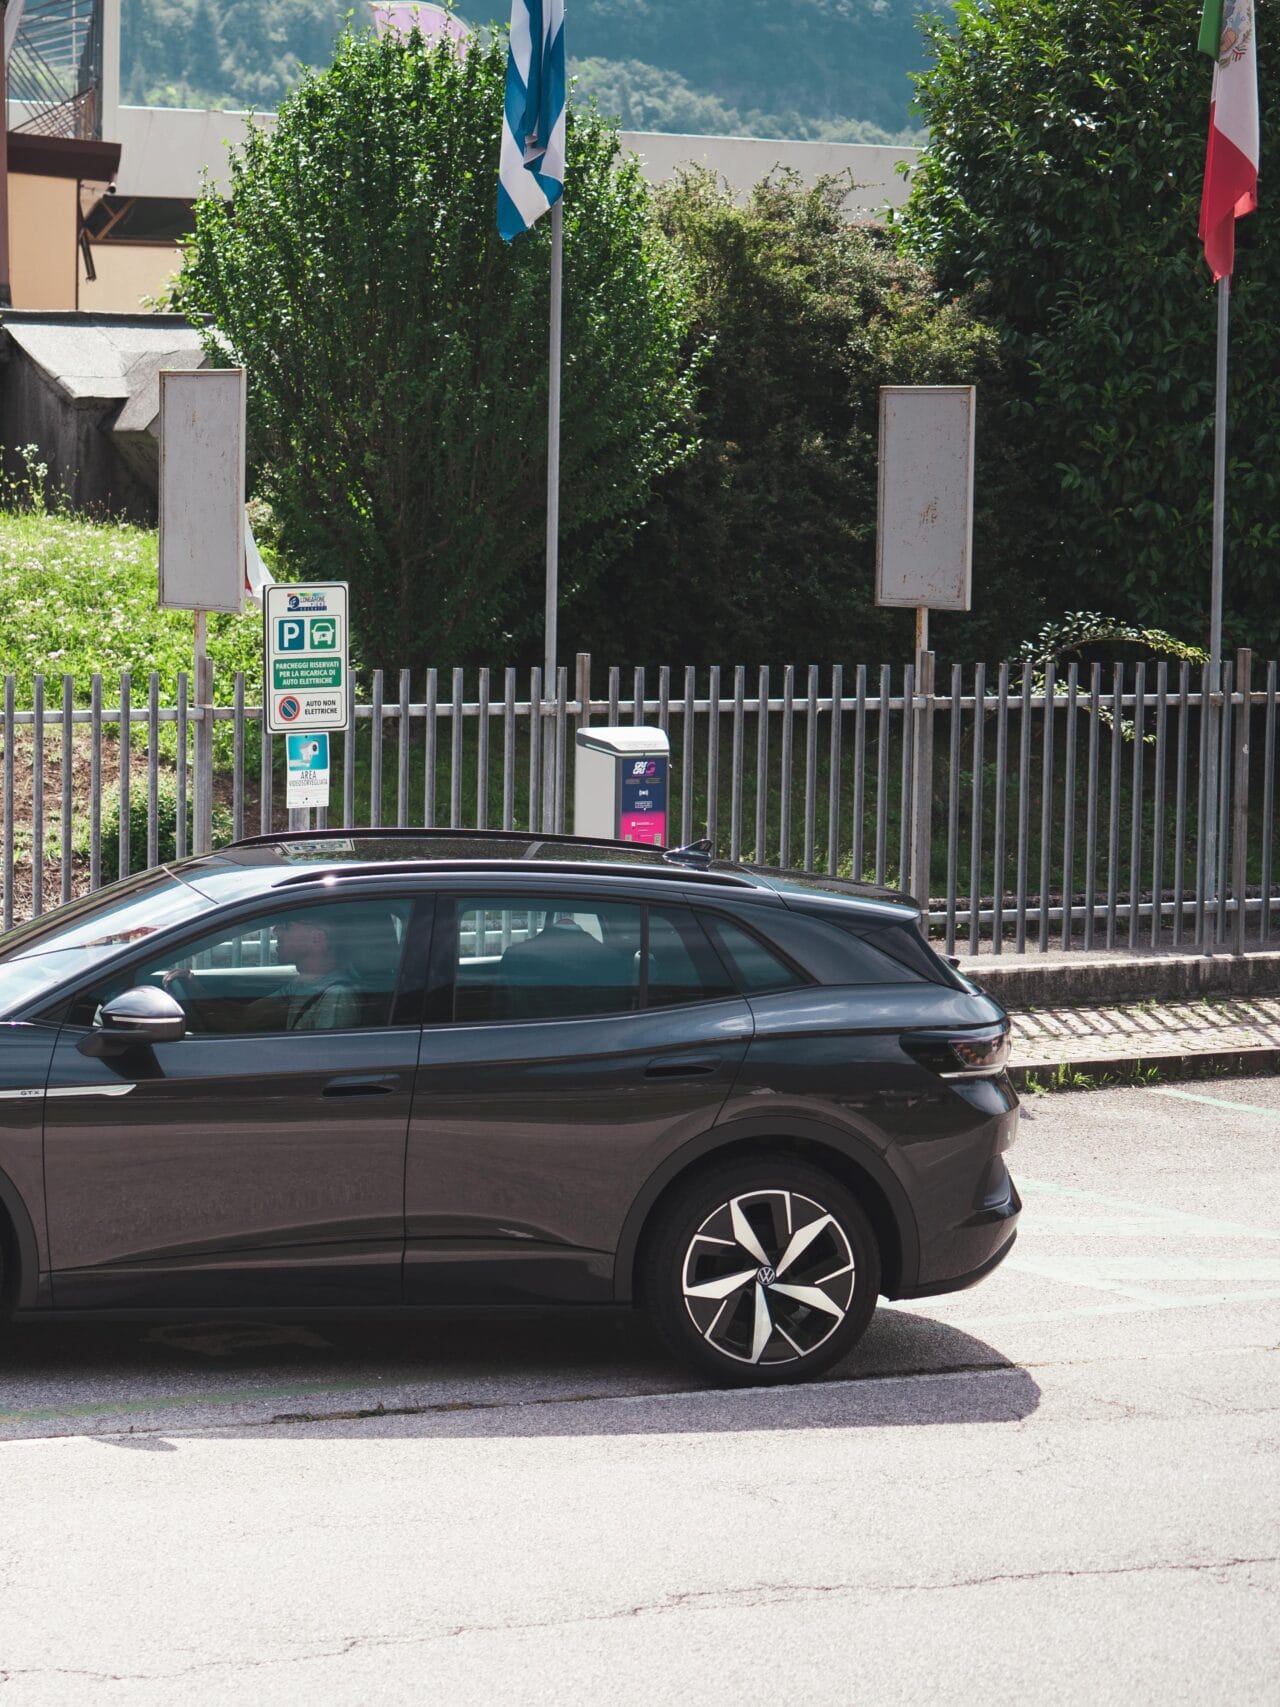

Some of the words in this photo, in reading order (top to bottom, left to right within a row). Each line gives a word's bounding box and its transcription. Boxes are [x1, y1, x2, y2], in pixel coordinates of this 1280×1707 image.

[283, 622, 300, 648] P
[279, 670, 290, 678] PER
[304, 707, 338, 715] ELETTRICHE
[300, 770, 317, 779] AREA
